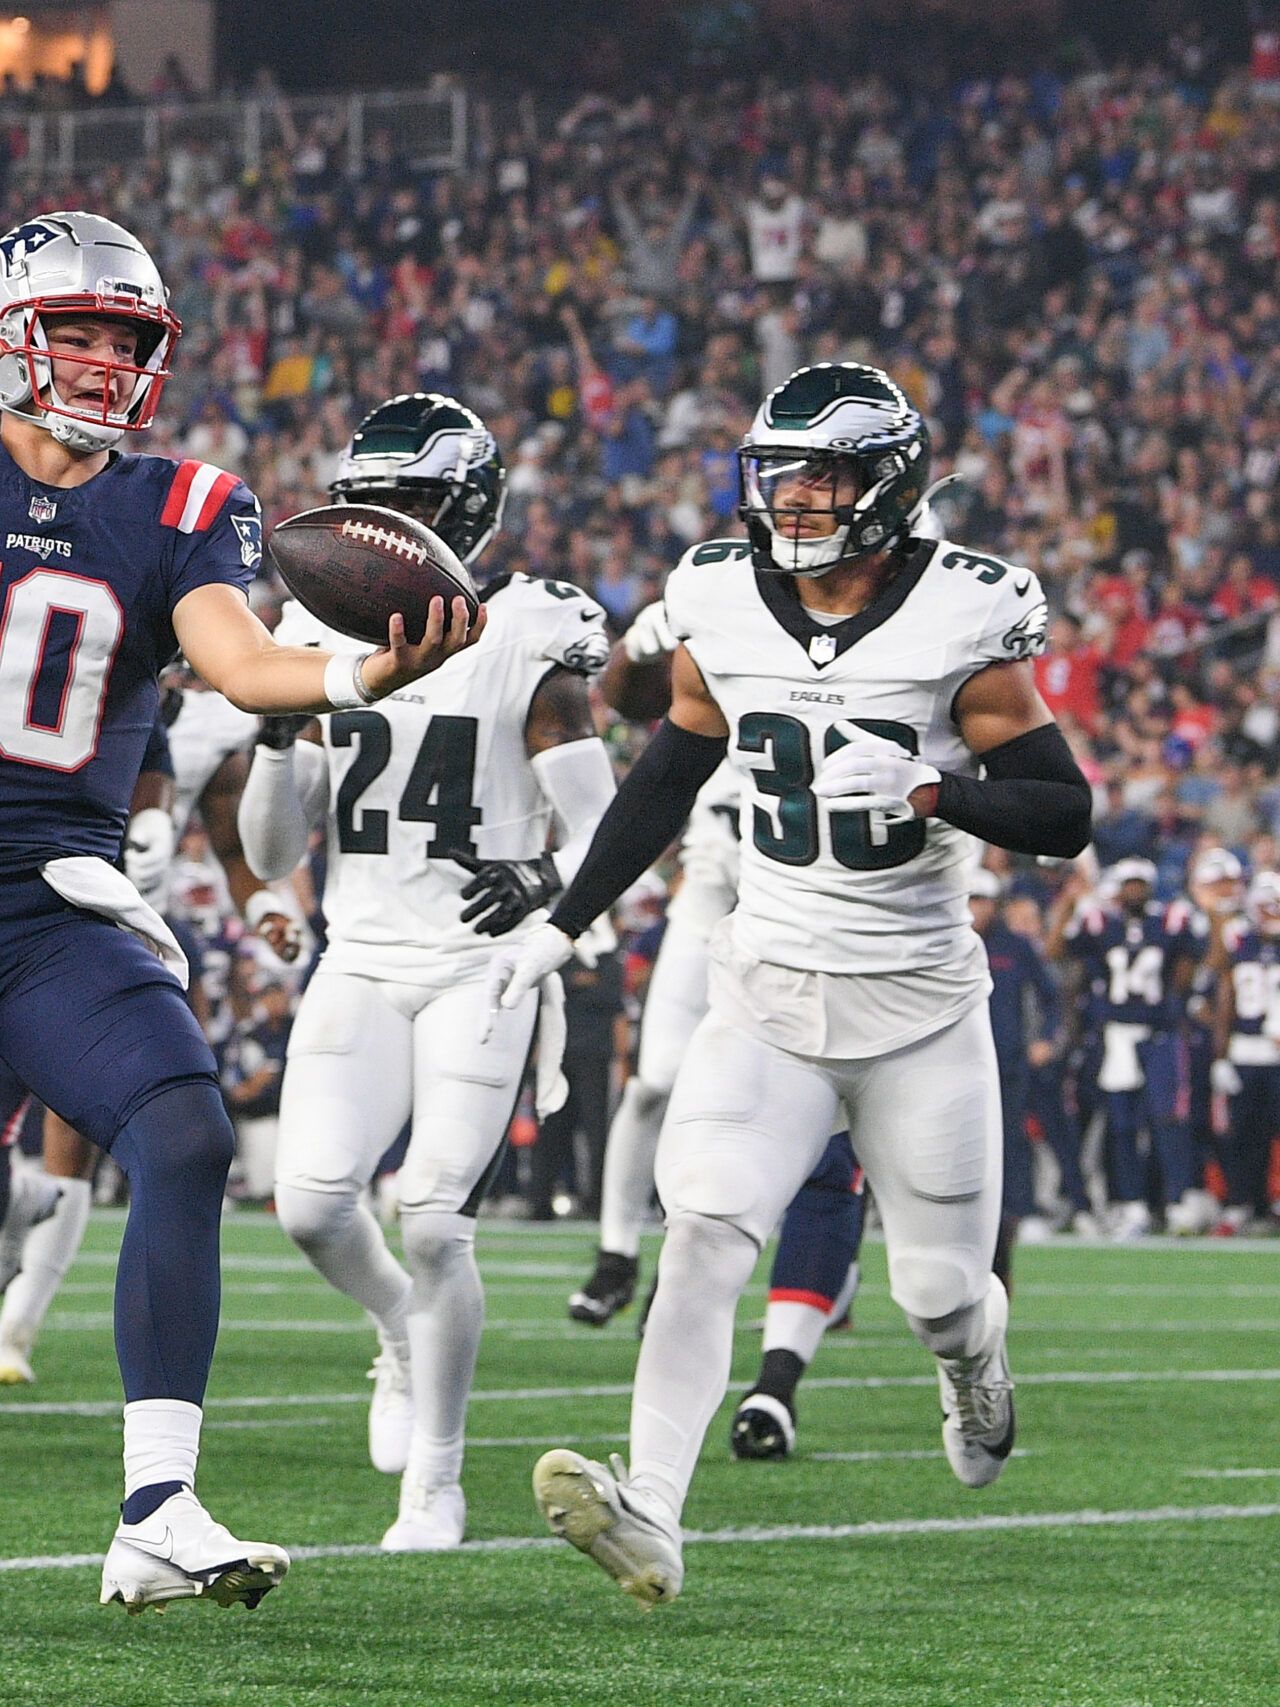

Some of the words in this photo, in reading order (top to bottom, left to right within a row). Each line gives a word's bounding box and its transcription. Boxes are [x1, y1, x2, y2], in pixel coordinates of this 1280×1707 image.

[6, 534, 72, 557] PATRIOTS
[789, 691, 846, 706] EAGLES
[330, 710, 483, 859] 24
[1106, 945, 1164, 1006] 14
